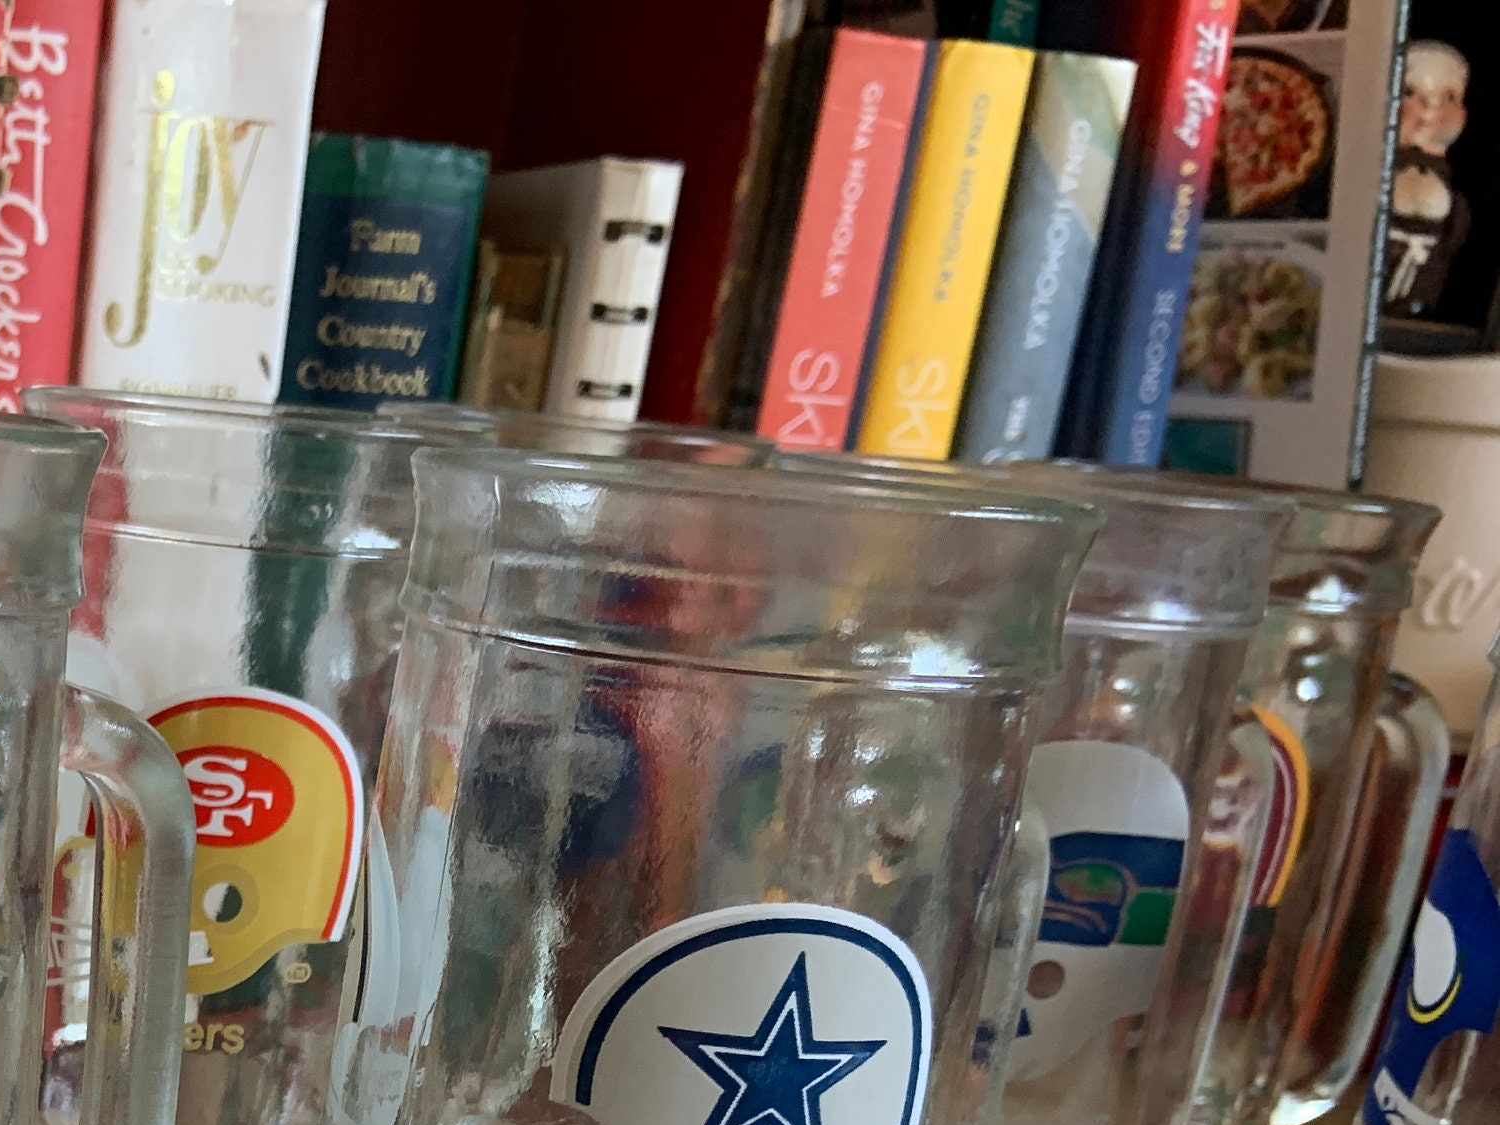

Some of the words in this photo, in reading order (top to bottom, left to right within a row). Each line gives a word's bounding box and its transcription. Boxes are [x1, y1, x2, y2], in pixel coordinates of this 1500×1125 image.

[853, 81, 885, 150] GINA
[316, 314, 427, 358] Country
[296, 357, 431, 398] Cookbook
[181, 1021, 246, 1054] ers
